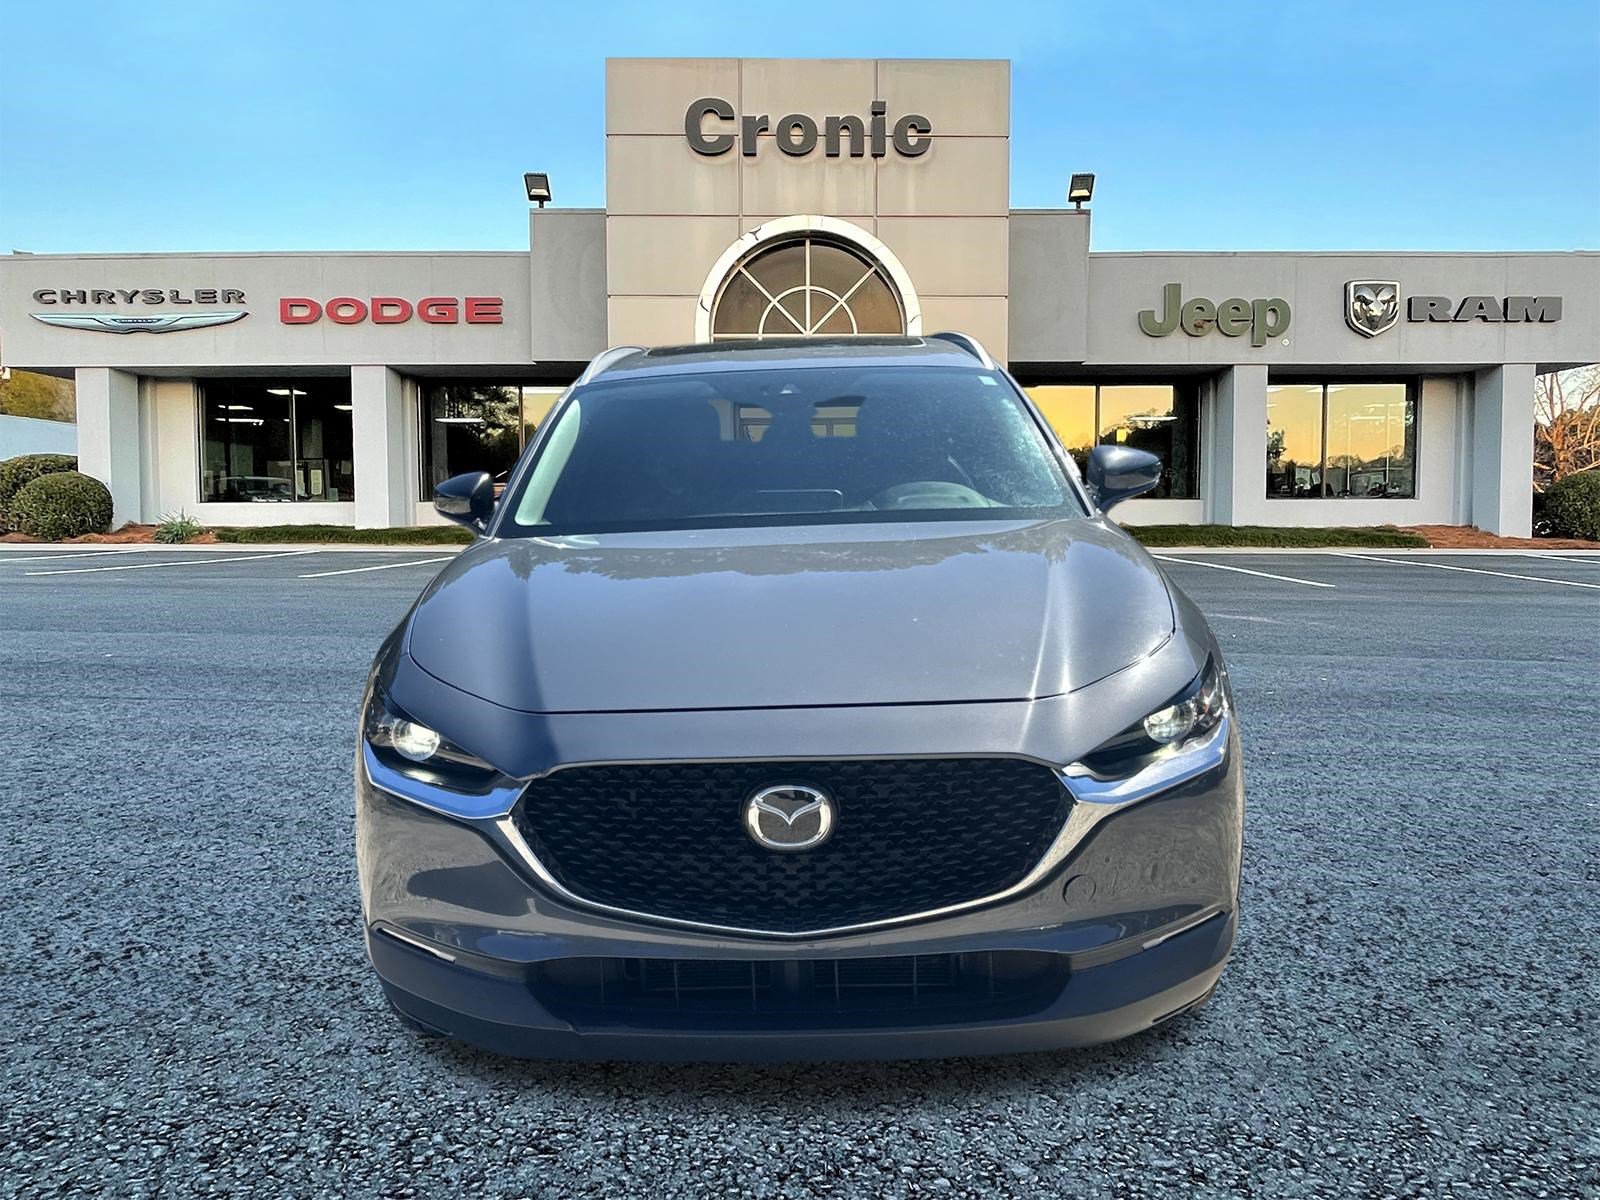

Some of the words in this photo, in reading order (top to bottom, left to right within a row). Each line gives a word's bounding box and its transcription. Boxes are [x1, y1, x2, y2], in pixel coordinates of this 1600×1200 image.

[685, 97, 932, 157] Cronic
[32, 289, 246, 304] CHRYSLER
[1407, 296, 1562, 322] RAM
[280, 297, 503, 325] DODGE
[1138, 283, 1291, 347] Jeep
